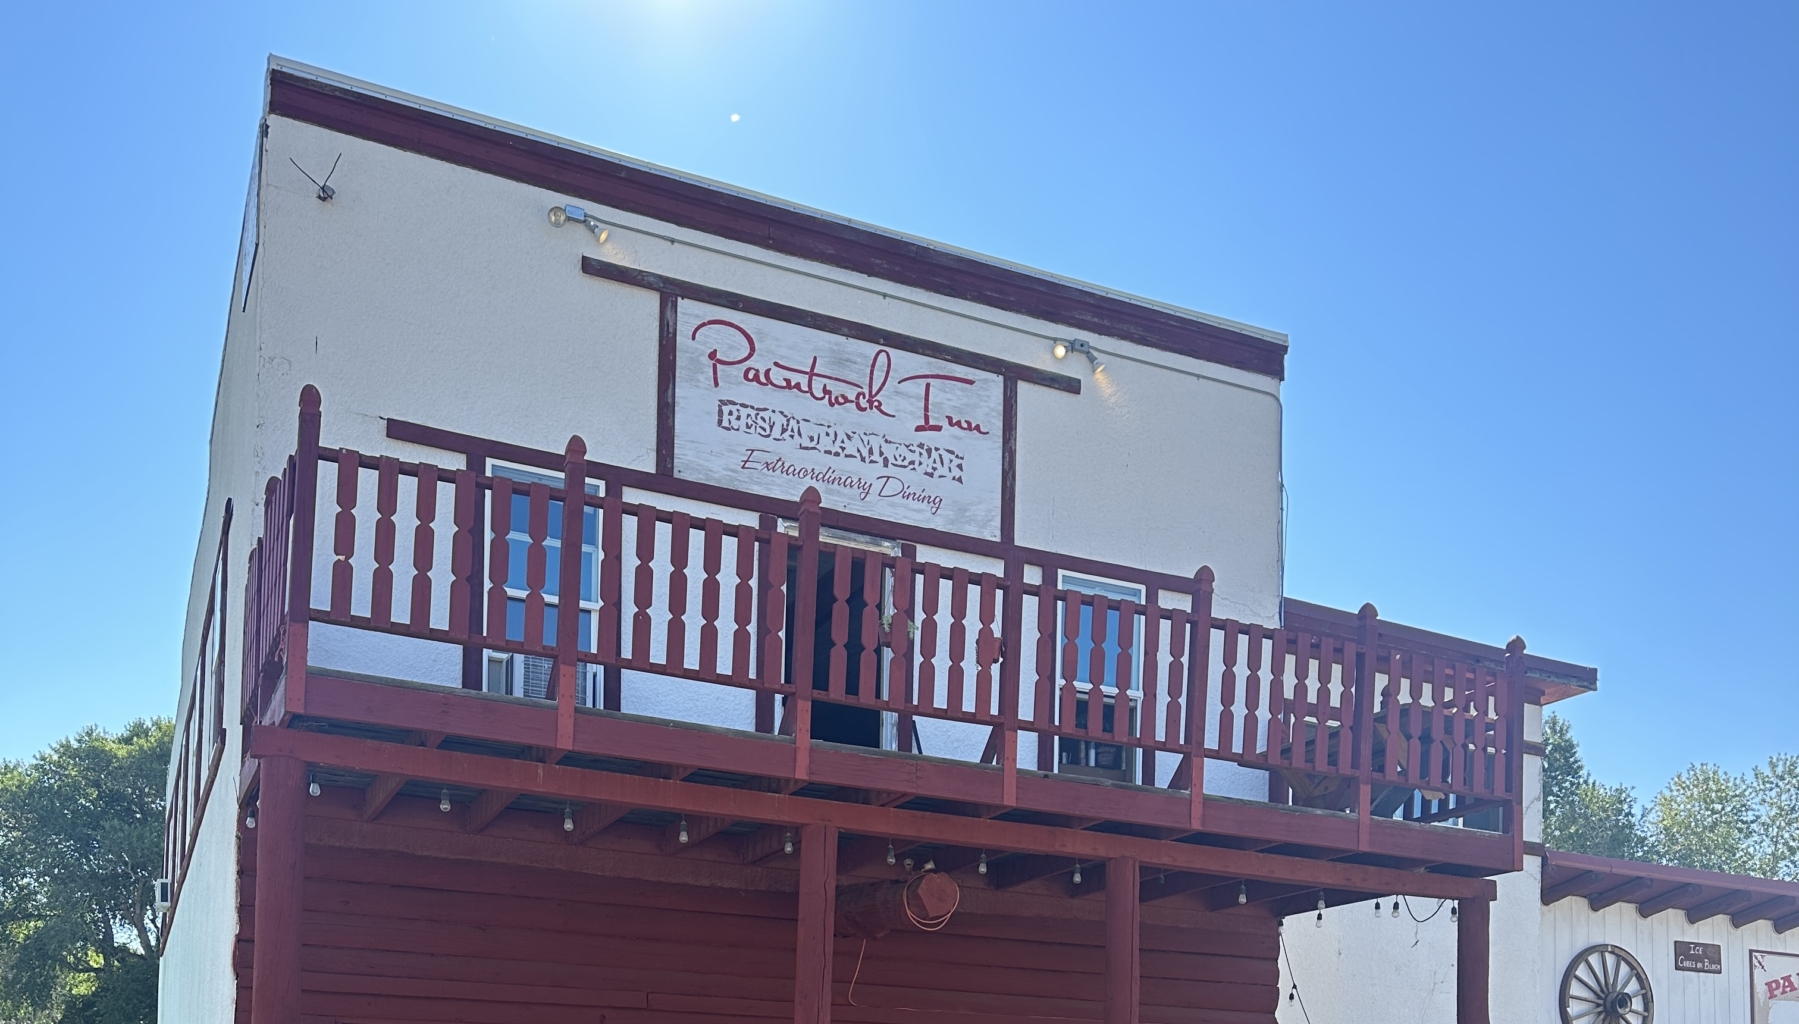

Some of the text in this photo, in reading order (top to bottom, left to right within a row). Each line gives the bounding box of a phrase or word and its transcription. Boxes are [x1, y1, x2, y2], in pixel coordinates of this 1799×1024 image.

[691, 318, 990, 436] Paintrock Inn
[740, 448, 944, 515] Extraordinary Dining
